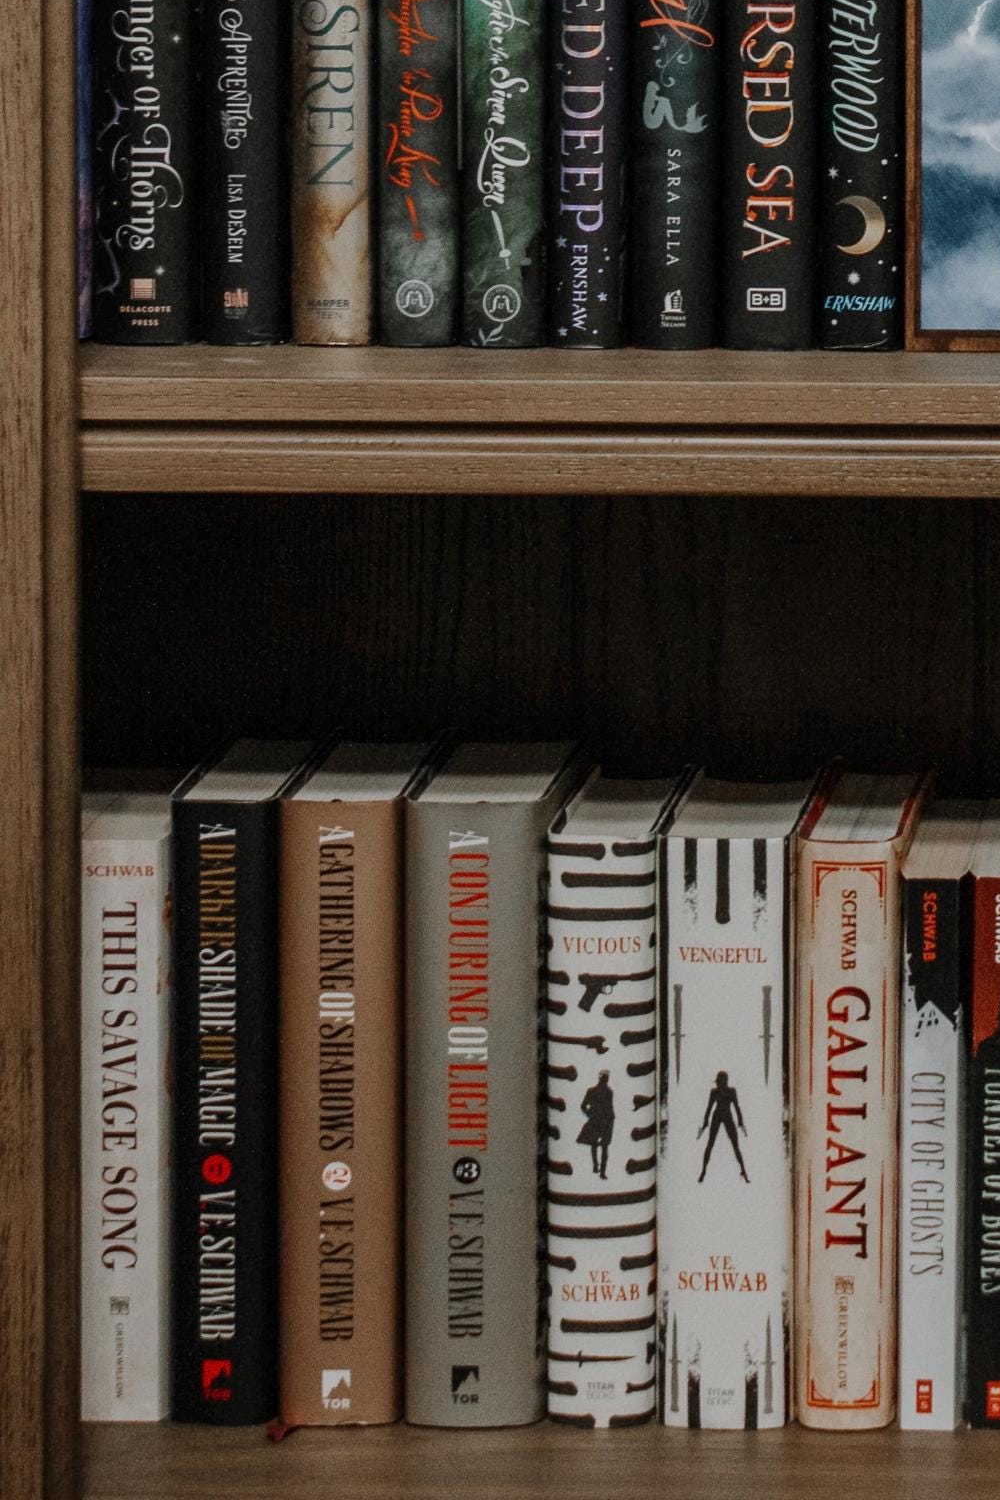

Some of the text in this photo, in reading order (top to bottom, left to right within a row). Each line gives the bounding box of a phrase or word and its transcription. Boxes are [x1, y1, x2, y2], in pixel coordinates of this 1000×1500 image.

[301, 0, 361, 188] SIREN
[560, 80, 605, 233] DEEP
[665, 148, 683, 267] SARA ELLA
[742, 162, 795, 261] SEA
[119, 304, 172, 313] DELACORTE
[131, 318, 160, 327] PRESS
[572, 244, 589, 331] ERNSHAW
[823, 294, 896, 312] ERNSHAW
[86, 864, 154, 878] SCHWAB
[562, 936, 642, 954] VICIOUS
[679, 946, 768, 964] VENGEFUL
[841, 889, 857, 972] SCHWAB
[922, 890, 937, 964] SCHWAB
[318, 842, 355, 1152] GATHERING SHADOWS
[448, 853, 489, 1154] CONJURING LIGHT
[101, 901, 138, 1272] THIS SAVAGE SONG
[199, 948, 236, 1148] SHADE MAGIC
[825, 985, 871, 1260] GALLANT
[909, 1071, 947, 1277] CITY OF GHOSTS
[561, 1283, 641, 1302] SCHWAB
[677, 1271, 768, 1293] SCHWAB
[115, 1322, 126, 1399] GREENWILLOW
[839, 1294, 849, 1390] GREENWILLOW
[322, 1398, 351, 1410] TOR
[452, 1394, 480, 1405] TOR
[586, 1381, 615, 1391] TITAN
[708, 1387, 735, 1397] TITAN
